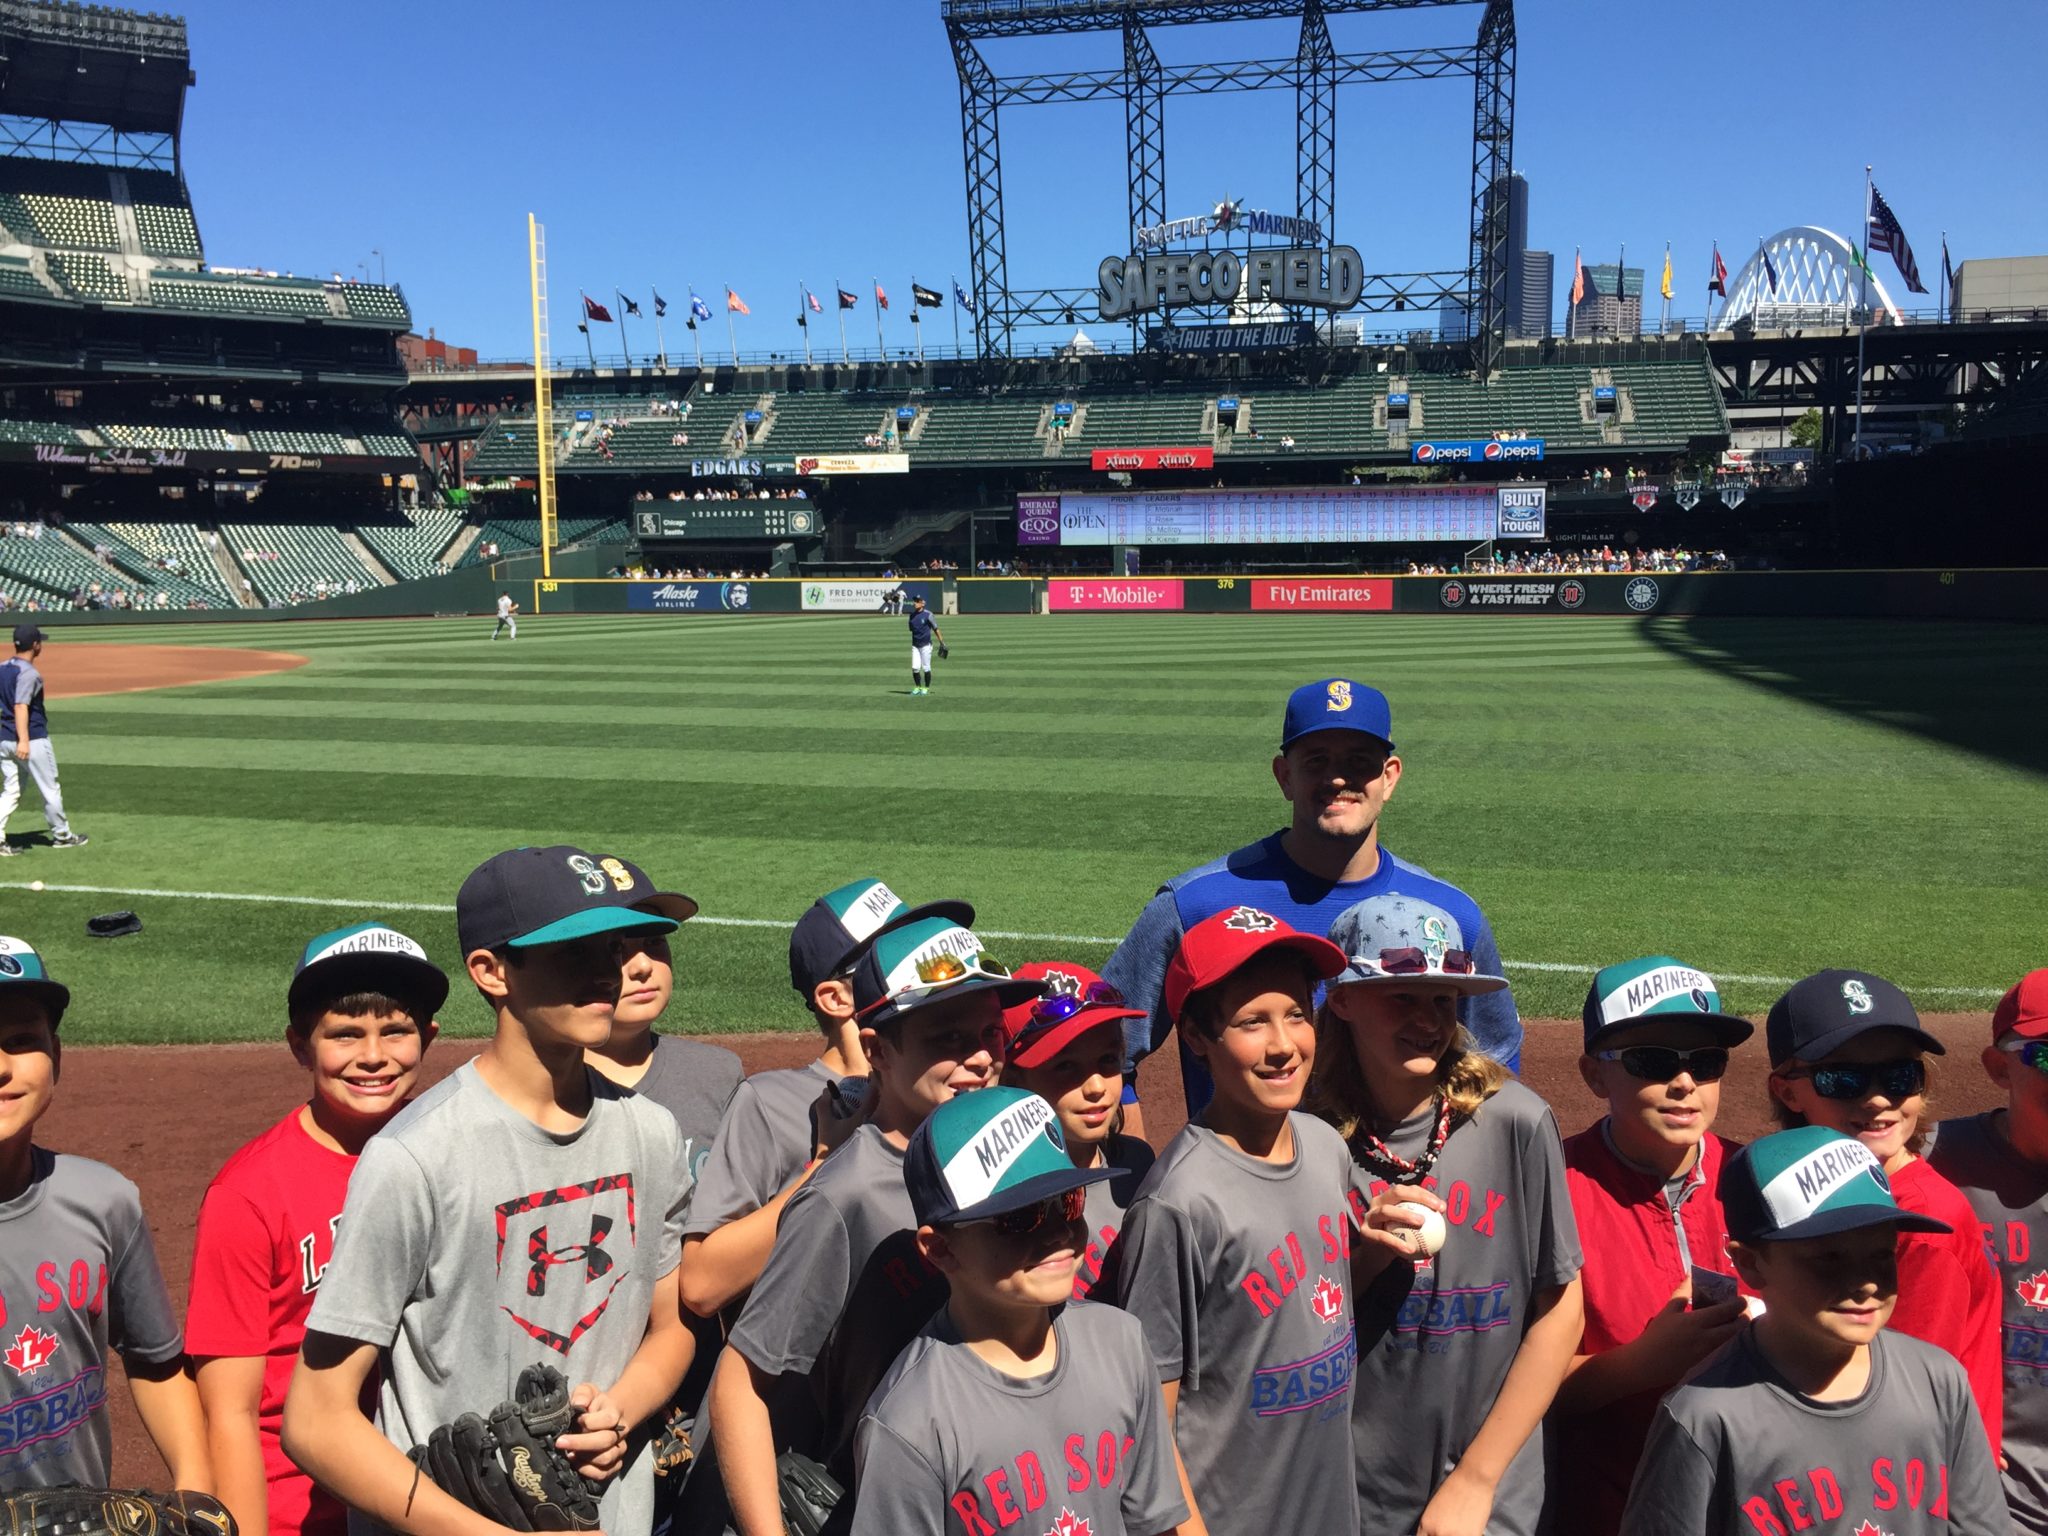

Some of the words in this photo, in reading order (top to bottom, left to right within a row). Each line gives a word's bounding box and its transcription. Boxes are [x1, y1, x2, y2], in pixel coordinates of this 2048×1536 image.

[1135, 216, 1208, 253] SEATTLE
[1248, 209, 1322, 244] MARINERS
[1098, 250, 1241, 322] SAFECO
[1246, 245, 1364, 312] FIELD
[1215, 329, 1232, 348] TO
[1234, 328, 1261, 347] THE
[35, 445, 87, 463] Welcome
[89, 452, 100, 464] to
[103, 449, 146, 466] Safeco
[149, 449, 186, 466] Field
[1436, 446, 1472, 460] pepsi
[1503, 444, 1540, 458] pepsi
[269, 455, 302, 469] 710
[1106, 453, 1144, 468] xfinity
[1158, 452, 1197, 467] xfinity
[1628, 485, 1659, 494] ROBINSON
[1673, 483, 1701, 492] GRIFFEY
[1715, 481, 1749, 490] MARTINEZ
[1502, 493, 1542, 507] BUILT
[1636, 494, 1651, 506] 42
[1680, 492, 1694, 504] 24
[1727, 491, 1738, 502] 11
[1019, 501, 1058, 509] EMERALD
[1025, 508, 1052, 516] QUEEN
[663, 519, 687, 527] Chicago
[1502, 520, 1540, 532] TOUGH
[1599, 533, 1615, 541] BAR
[1217, 579, 1235, 590] 376
[1939, 572, 1955, 585] 401
[542, 582, 558, 592] 331
[652, 584, 699, 600] Alaska
[829, 589, 853, 597] FRED
[855, 589, 887, 597] HUTCH
[1468, 584, 1512, 595] WHERE
[1512, 584, 1555, 595] FRESH
[1269, 586, 1297, 605] Fly
[1300, 585, 1372, 602] Emirates
[1470, 594, 1481, 605] &
[1481, 594, 1514, 605] FAST
[1513, 594, 1551, 605] MEET
[1326, 680, 1353, 712] S
[1627, 971, 1704, 1013] MARINERS
[1840, 979, 1874, 1016] S
[974, 1103, 1049, 1179] MARINERS
[1795, 1144, 1872, 1204] MARINERS
[1241, 1232, 1307, 1319] RED
[1323, 1290, 1337, 1317] L
[22, 1338, 42, 1368] L
[510, 1445, 548, 1502] Rawlings
[950, 1449, 1048, 1536] RED
[1740, 1465, 1845, 1536] RED
